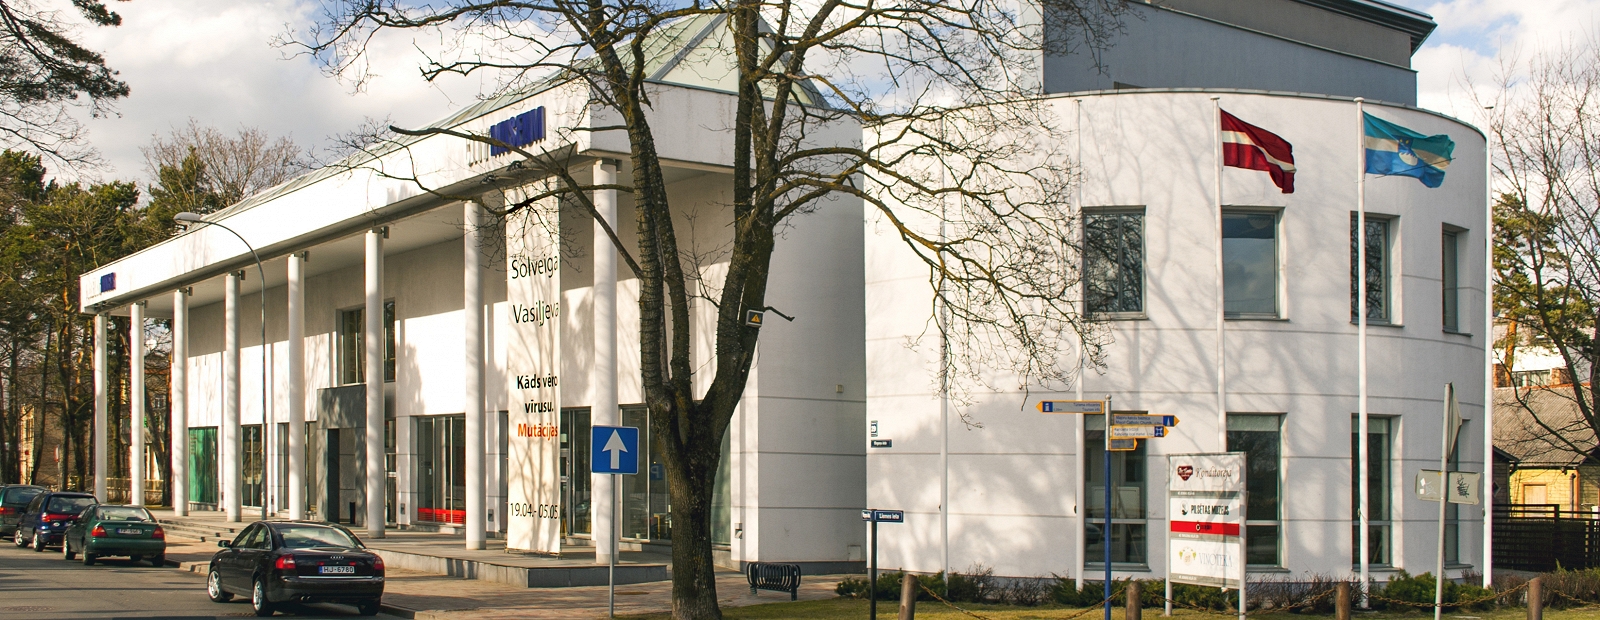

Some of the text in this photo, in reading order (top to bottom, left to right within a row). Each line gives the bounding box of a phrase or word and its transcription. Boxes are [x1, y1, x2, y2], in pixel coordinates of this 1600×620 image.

[511, 253, 559, 279] Solveiga
[516, 373, 541, 390] Kāds
[524, 399, 554, 413] vīrusu.
[517, 422, 558, 441] Mutācijas
[1190, 503, 1211, 514] PILSĒTAS
